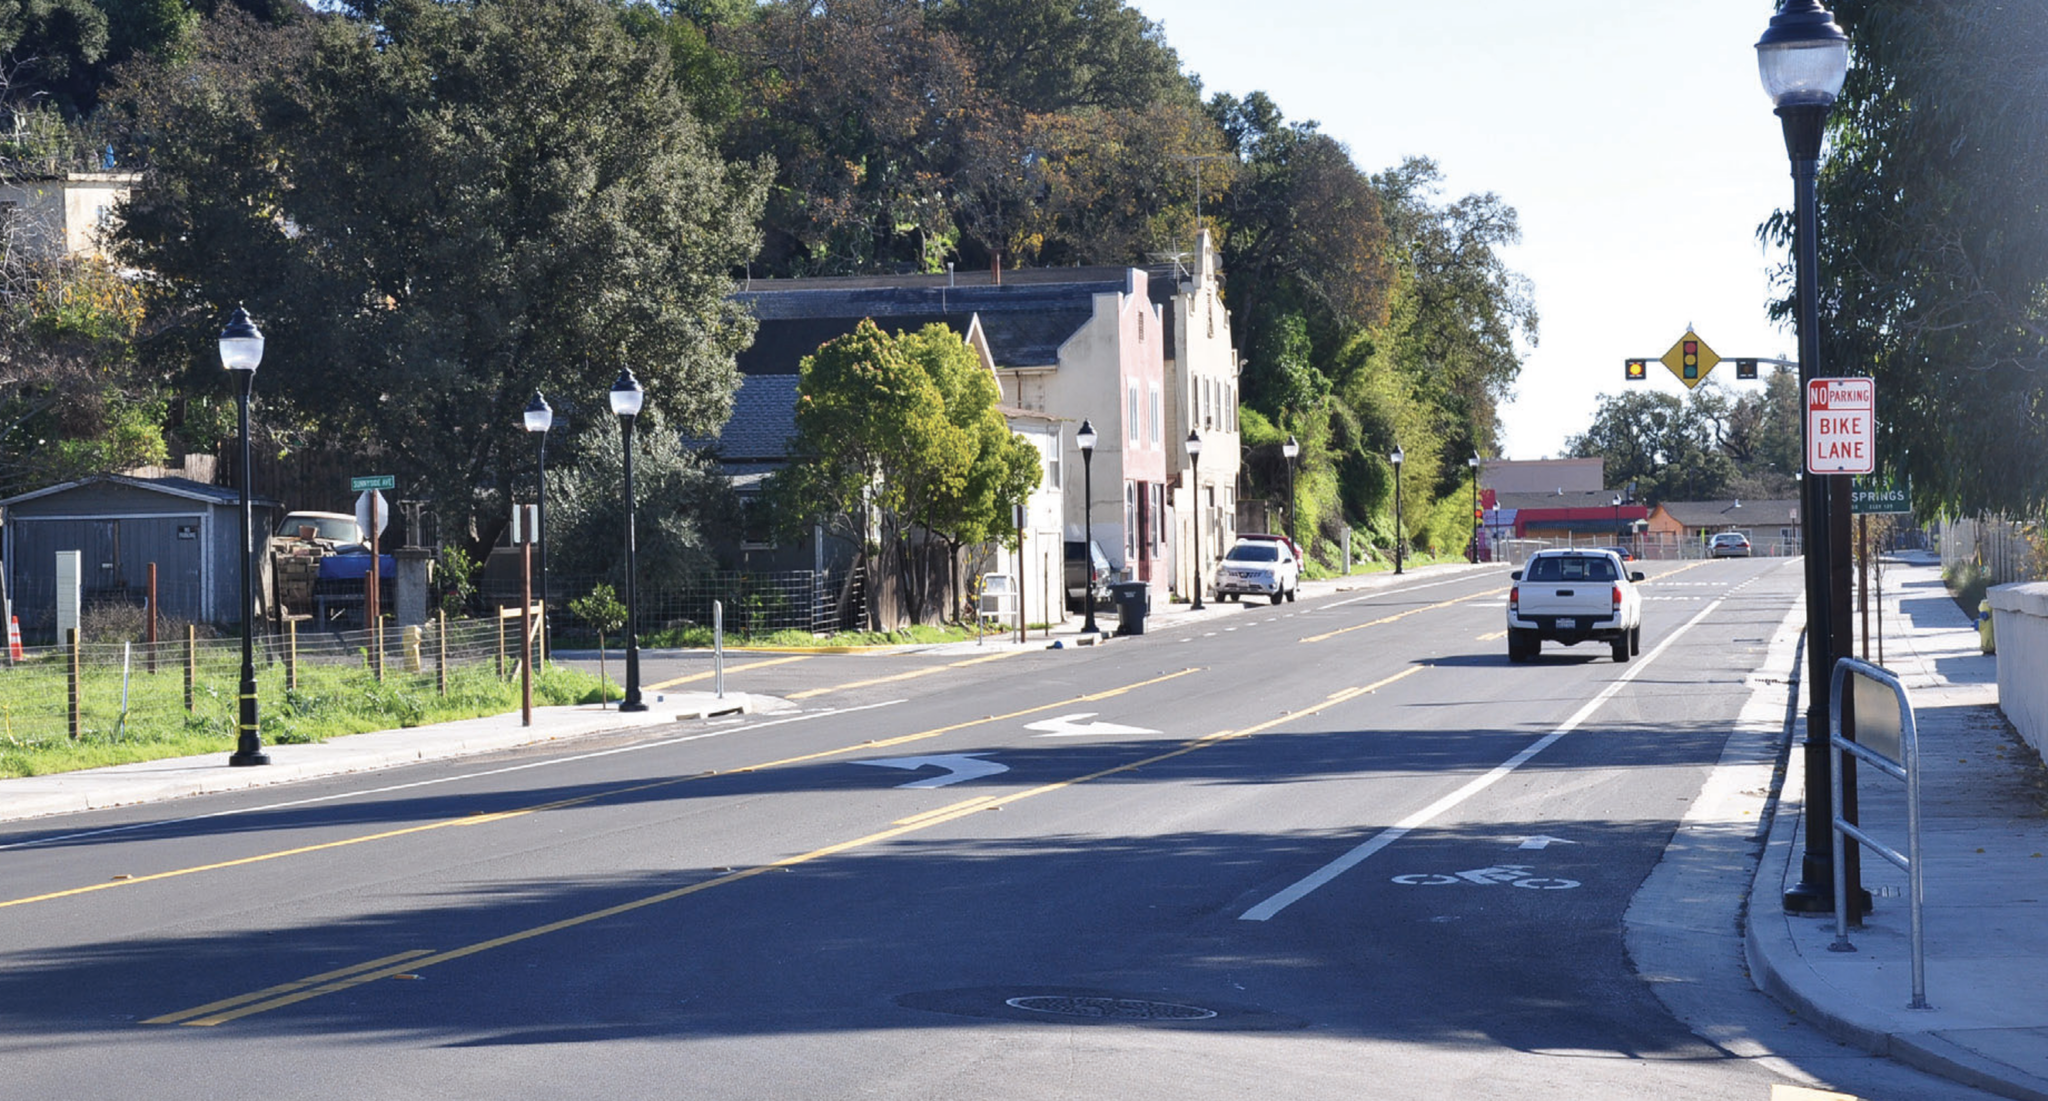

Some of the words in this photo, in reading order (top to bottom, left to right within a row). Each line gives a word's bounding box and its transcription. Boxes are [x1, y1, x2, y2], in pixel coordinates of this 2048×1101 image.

[1810, 387, 1827, 405] NO
[1829, 390, 1869, 402] PARKING
[1820, 418, 1861, 434] BIKE
[1818, 442, 1864, 459] LANE
[353, 479, 380, 488] SUNNYSIDE
[382, 478, 391, 486] AVE
[1852, 490, 1905, 502] SPRINGS
